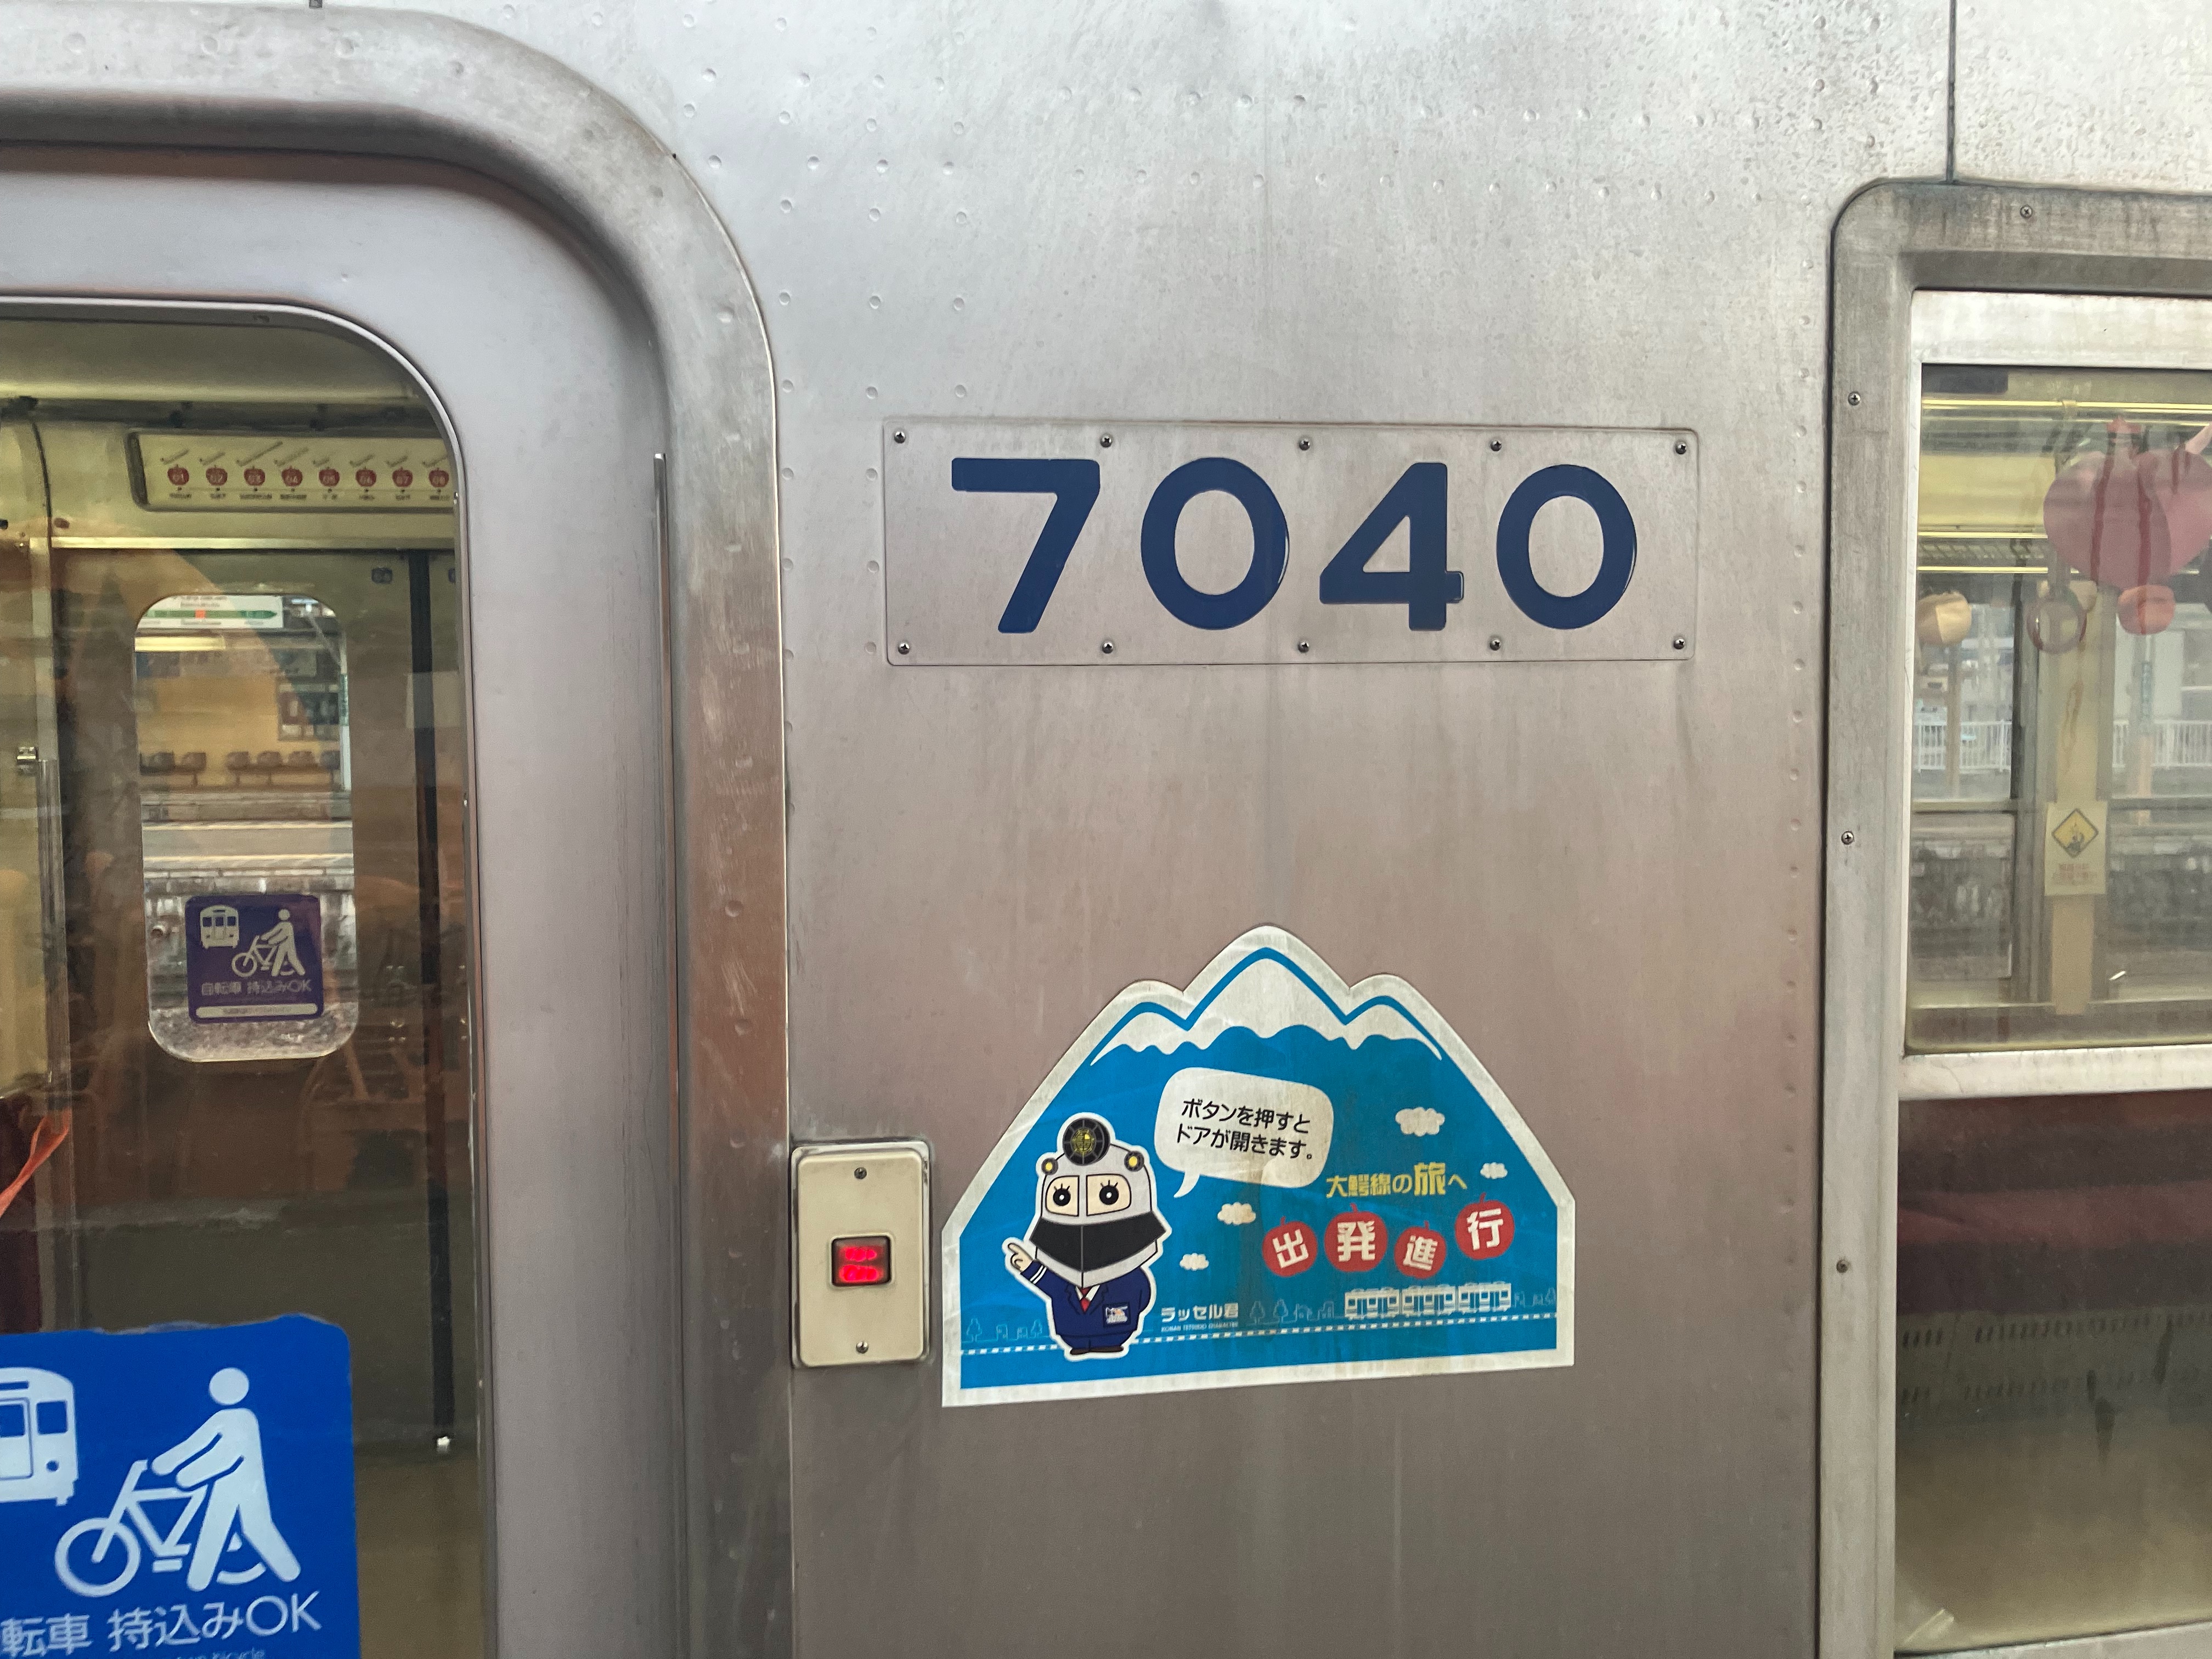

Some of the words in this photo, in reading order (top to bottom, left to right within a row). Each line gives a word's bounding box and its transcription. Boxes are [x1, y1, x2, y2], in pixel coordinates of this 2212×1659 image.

[951, 457, 1637, 633] 7040
[1181, 1098, 1311, 1134] ボタンを押すと
[1177, 1123, 1313, 1160] ドアが開きます。
[1325, 1162, 1468, 1198] 大鰐線の旅へ
[1272, 1208, 1504, 1271] 出発進行
[1161, 1302, 1239, 1323] ラッセル君
[0, 1613, 92, 1658] 転車
[108, 1590, 321, 1652] 持込みOK
